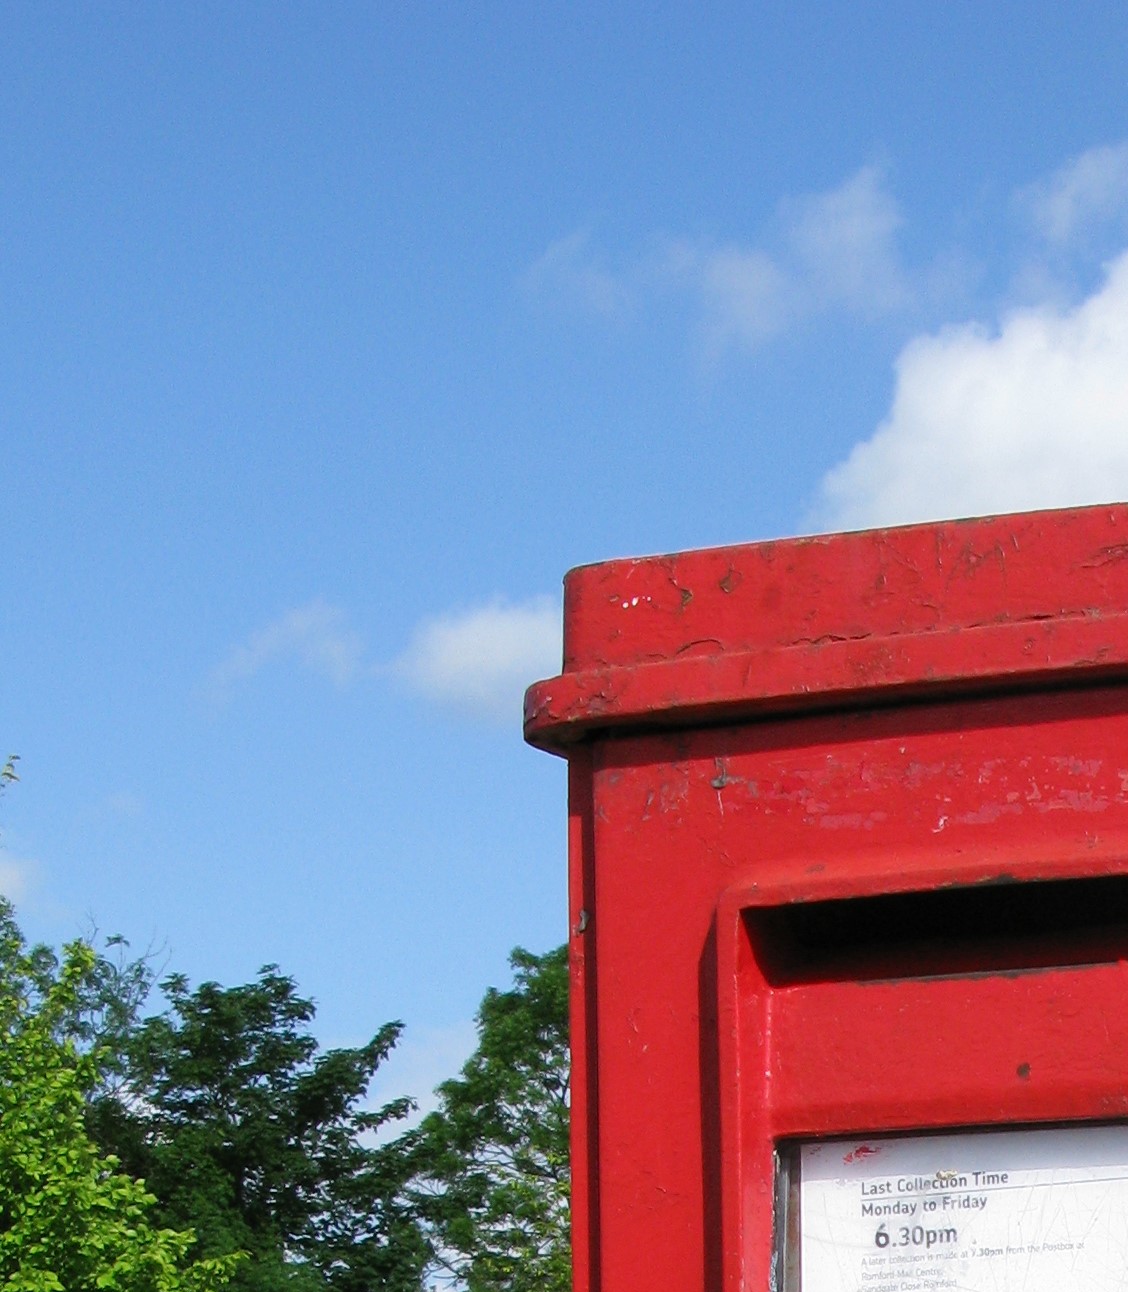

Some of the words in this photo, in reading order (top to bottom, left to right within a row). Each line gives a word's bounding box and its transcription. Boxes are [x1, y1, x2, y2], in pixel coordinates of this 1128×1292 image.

[861, 1181, 892, 1196] Last
[897, 1176, 967, 1193] Collection
[972, 1170, 1009, 1186] Time
[861, 1203, 917, 1217] Monday
[923, 1202, 937, 1212] to
[942, 1195, 988, 1211] Friday
[874, 1222, 958, 1249] 6.30pm
[1006, 1245, 1025, 1254] from
[1027, 1244, 1040, 1252] the
[1042, 1242, 1074, 1251] Postbox
